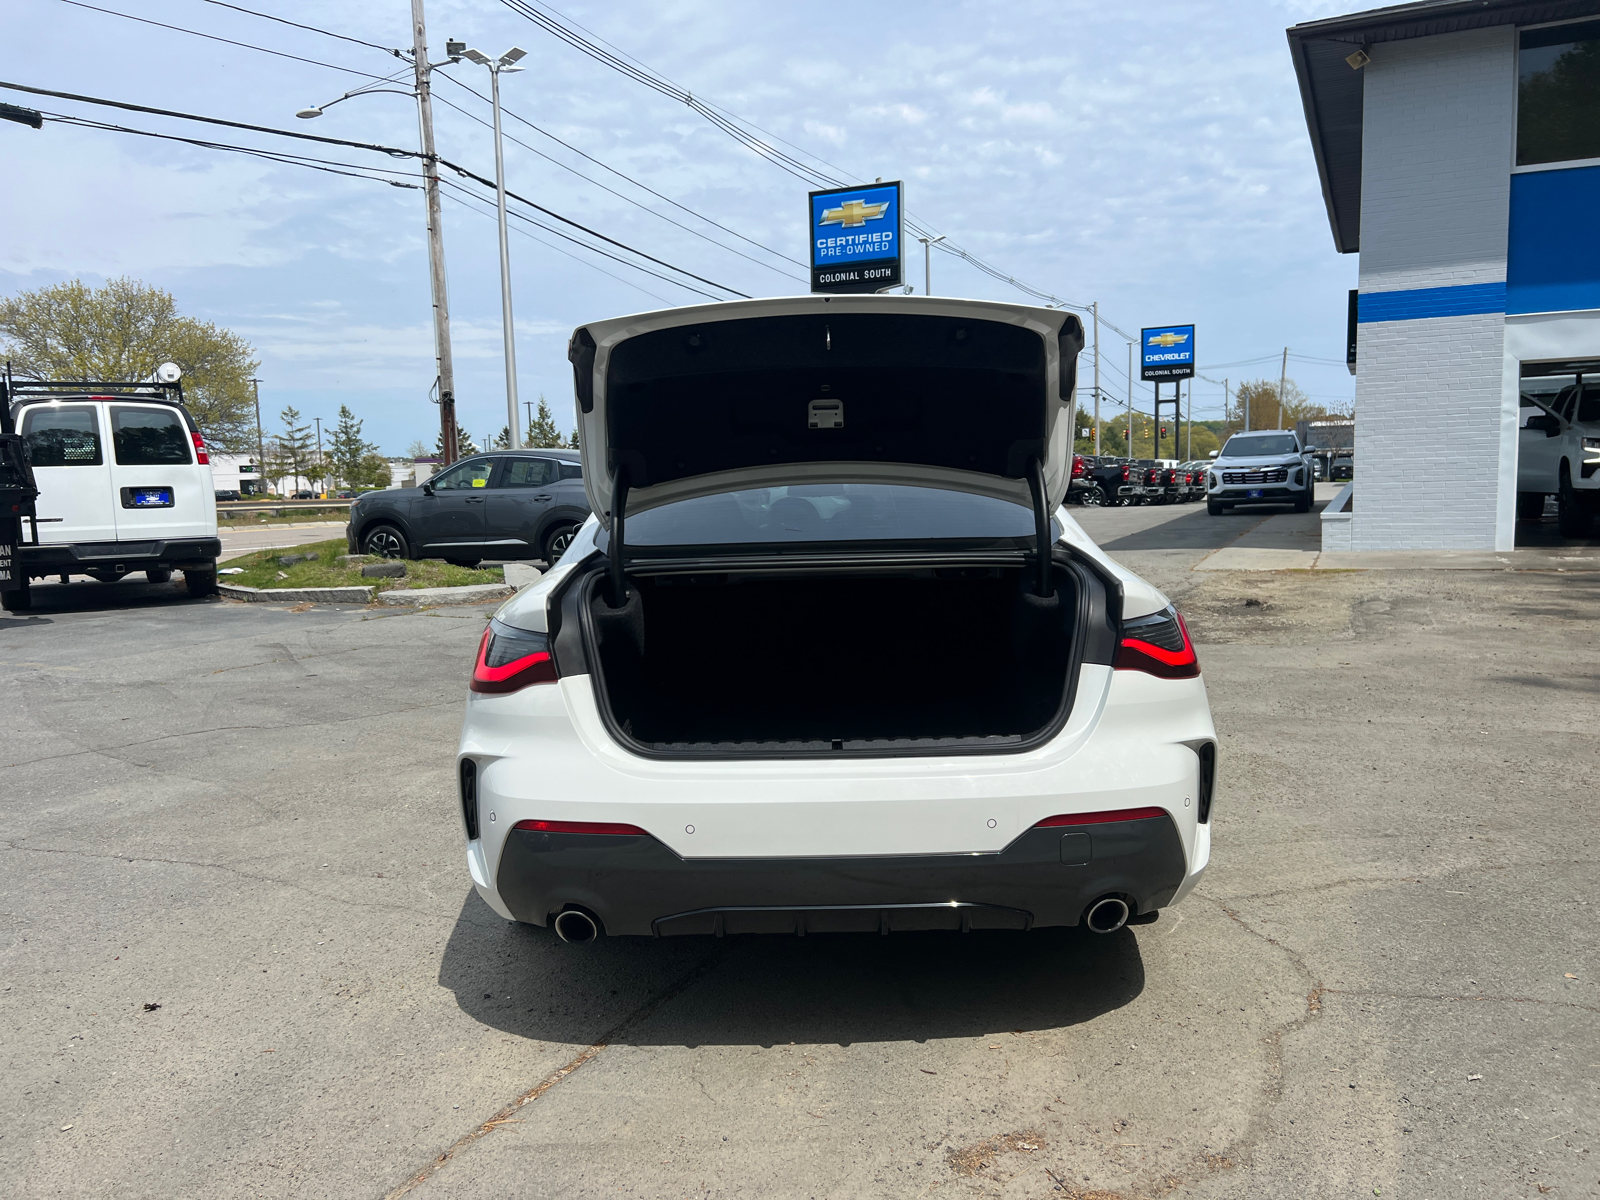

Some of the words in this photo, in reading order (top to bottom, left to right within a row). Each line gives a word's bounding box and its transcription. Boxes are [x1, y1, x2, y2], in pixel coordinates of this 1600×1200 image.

[817, 232, 893, 248] CERTIFIED
[820, 242, 889, 257] PRE-OWNED
[820, 271, 859, 283] COLONIAL
[864, 269, 891, 279] SOUTH
[1146, 353, 1190, 362] CHEVROLET
